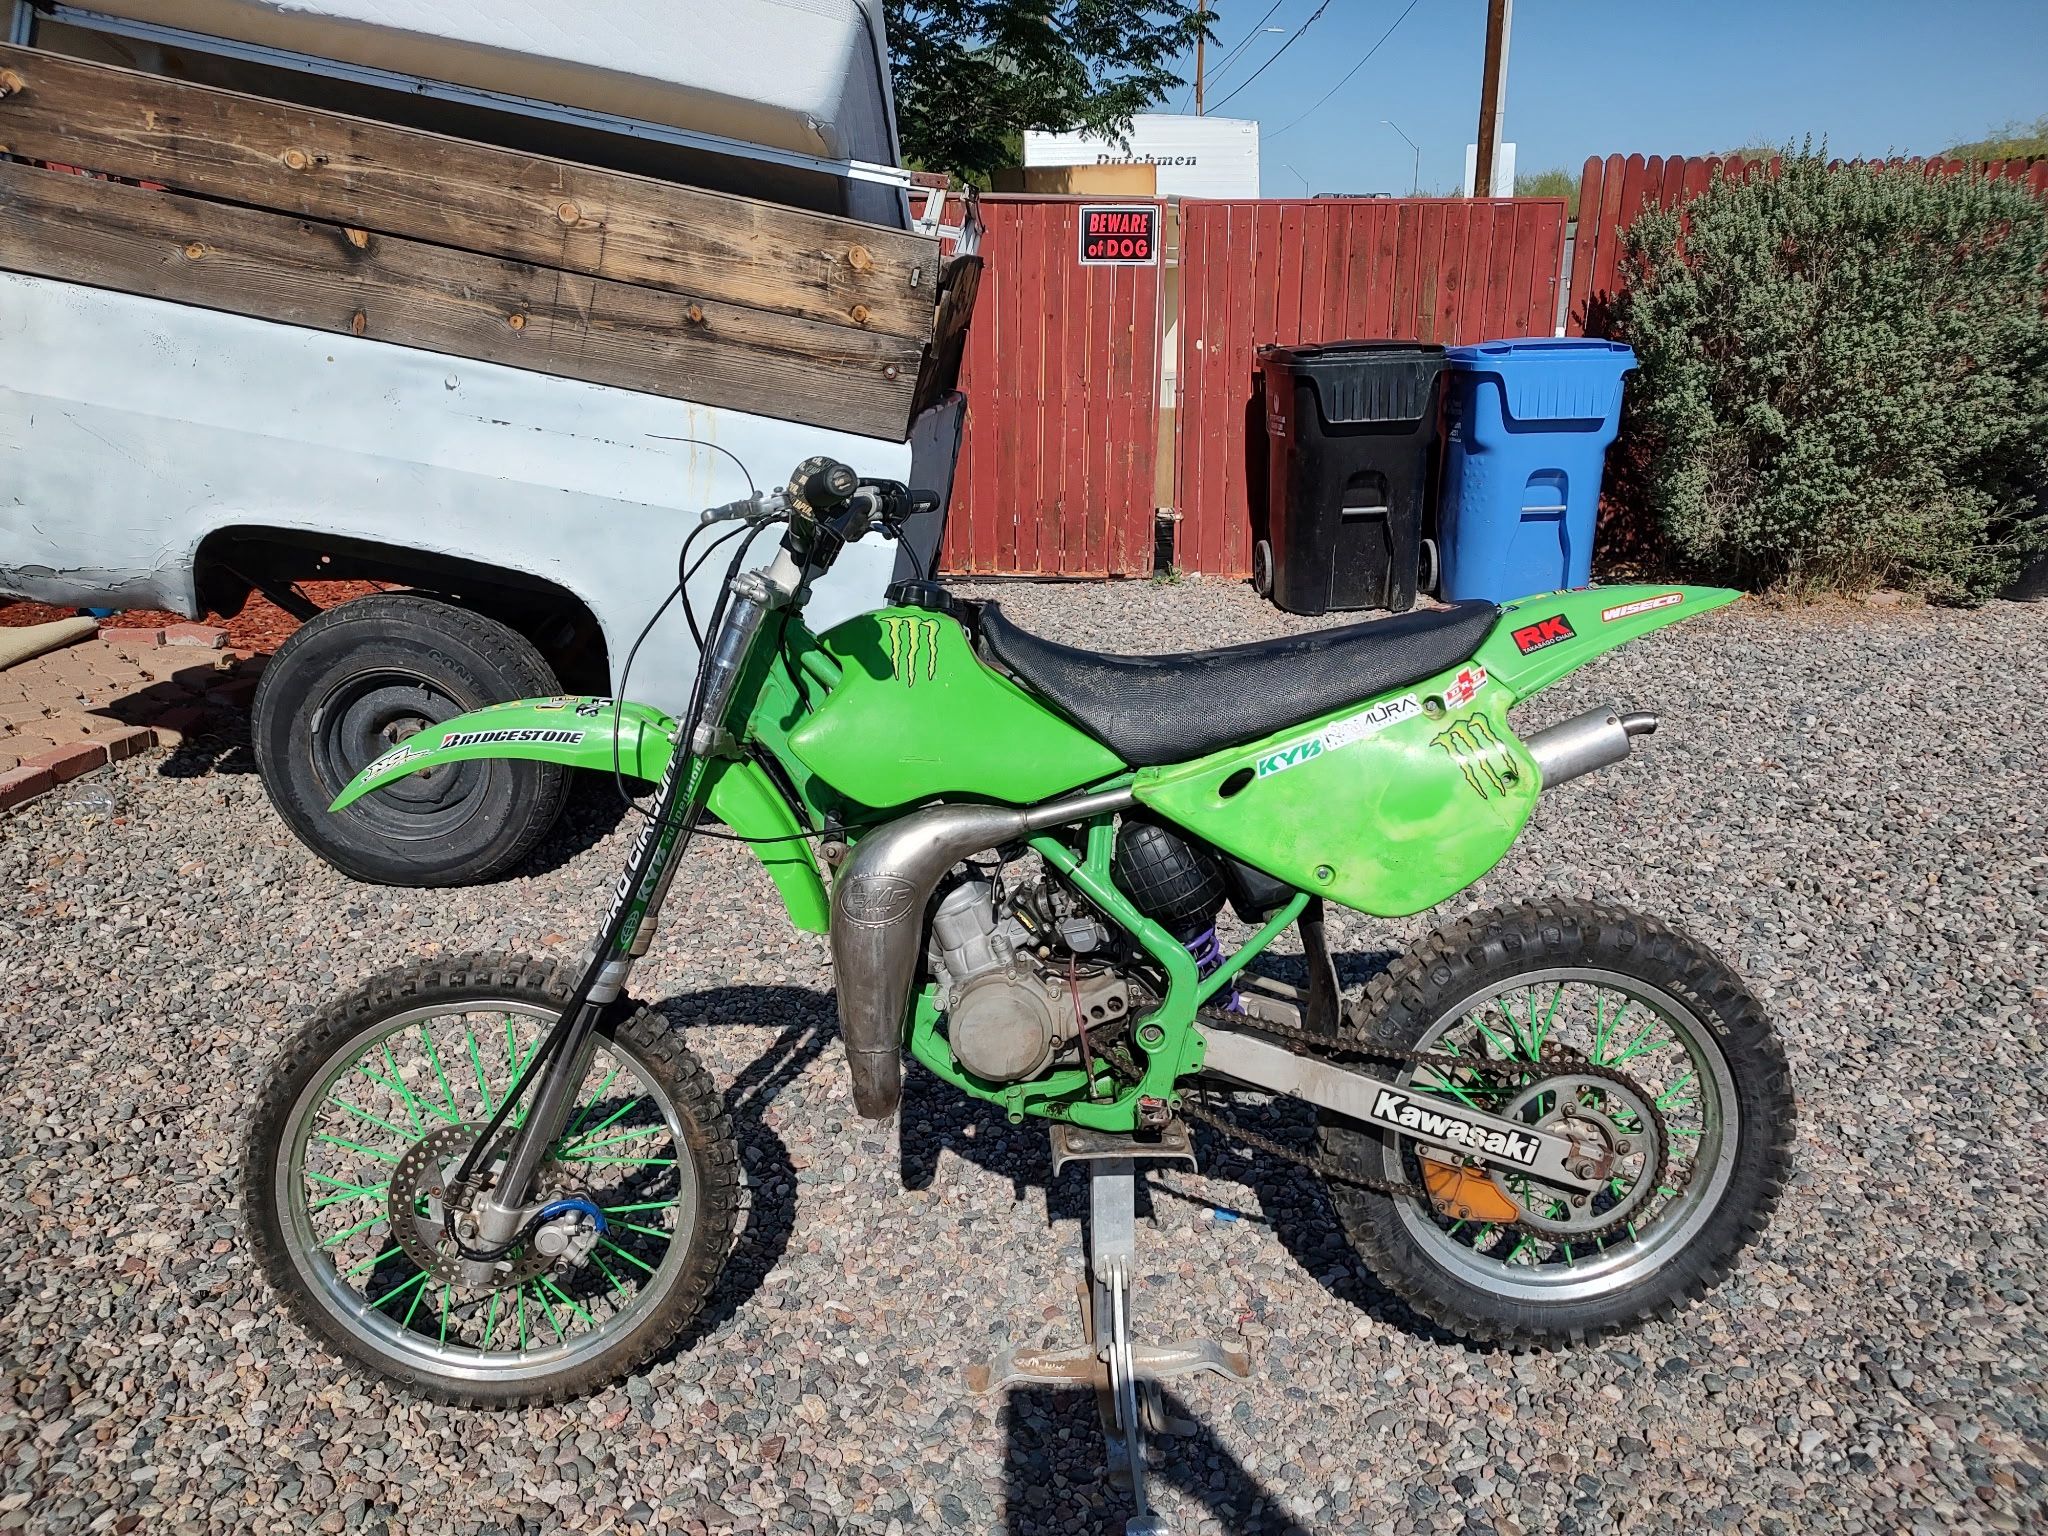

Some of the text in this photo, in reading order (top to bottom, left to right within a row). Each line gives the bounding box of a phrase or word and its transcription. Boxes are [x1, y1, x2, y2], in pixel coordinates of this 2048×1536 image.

[1096, 153, 1197, 166] Dutchmen
[1089, 213, 1149, 233] BEWARE
[1088, 239, 1148, 257] of DOG
[1603, 593, 1682, 621] WISECO
[1513, 616, 1571, 649] RK
[1522, 637, 1556, 654] TAKASAGO
[443, 730, 584, 750] BRIDGESTONE
[1258, 739, 1323, 776] KYB
[636, 847, 667, 903] KYB
[1373, 1090, 1540, 1165] Kawasaki
